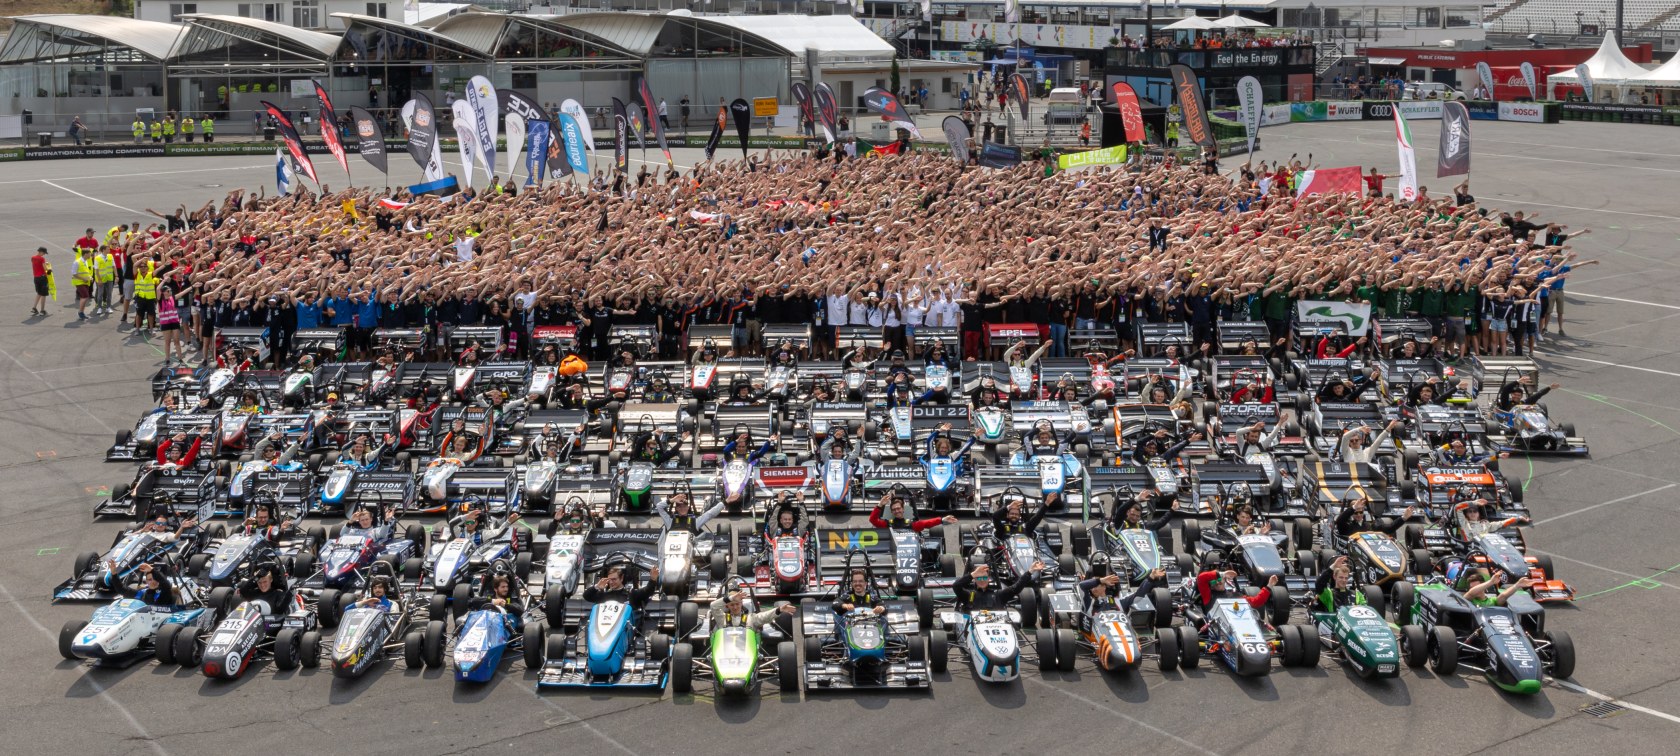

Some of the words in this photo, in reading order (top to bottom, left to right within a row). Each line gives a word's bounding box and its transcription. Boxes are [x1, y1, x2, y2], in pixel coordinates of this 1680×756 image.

[1217, 54, 1233, 63] Feel
[1236, 54, 1249, 63] the
[1251, 54, 1278, 64] Energy
[1245, 82, 1255, 138] SCHAEFFLER
[564, 122, 582, 166] ecurieaix
[913, 408, 945, 416] DUT
[947, 408, 967, 416] 22
[829, 531, 879, 550] NXP
[896, 558, 918, 568] 172
[1354, 608, 1376, 617] 36
[1098, 613, 1128, 623] 326
[1244, 643, 1268, 654] 66
[1347, 638, 1367, 658] SIEMENS
